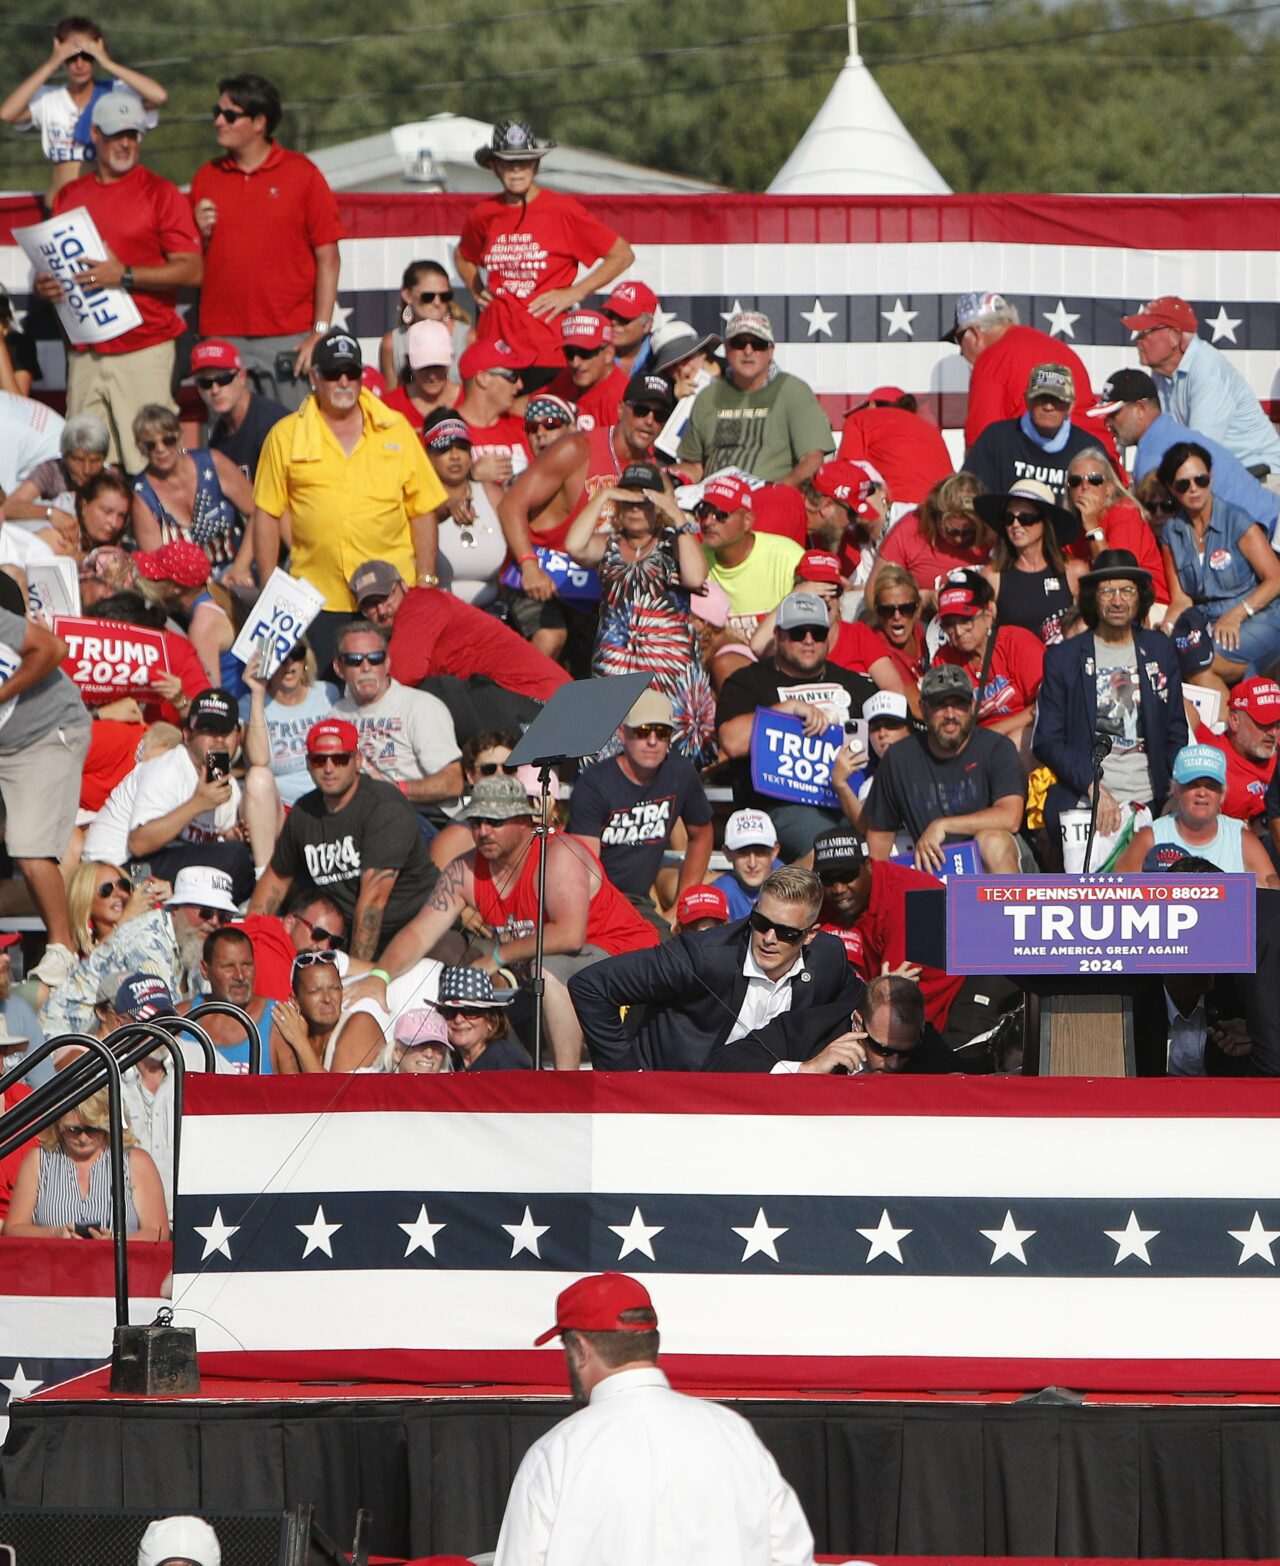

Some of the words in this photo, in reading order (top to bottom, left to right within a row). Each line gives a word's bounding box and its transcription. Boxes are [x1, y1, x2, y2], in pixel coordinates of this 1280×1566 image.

[54, 224, 118, 327] FIED!
[1014, 460, 1068, 485] TRUM
[834, 485, 851, 499] 45
[64, 634, 160, 667] TRUMP
[73, 659, 149, 685] 2024
[765, 727, 845, 765] TRUM
[777, 753, 832, 786] 202
[787, 779, 819, 794] TRUMP
[610, 800, 670, 828] ULTRA
[736, 820, 765, 832] 2024
[601, 818, 667, 846] MAGA
[828, 836, 859, 848] AMERICA
[834, 847, 855, 859] AGAIN
[984, 888, 1022, 901] TEXT
[1026, 887, 1144, 901] PENNSYLVANIA
[1148, 887, 1168, 900] TO
[1171, 887, 1220, 900] 88022
[1003, 904, 1200, 941] TRUMP
[1013, 946, 1047, 956] MAKE
[1050, 946, 1103, 956] AMERICA
[1105, 946, 1144, 955] GREAT
[1147, 945, 1190, 955] AGAIN!
[1079, 959, 1124, 973] 2024
